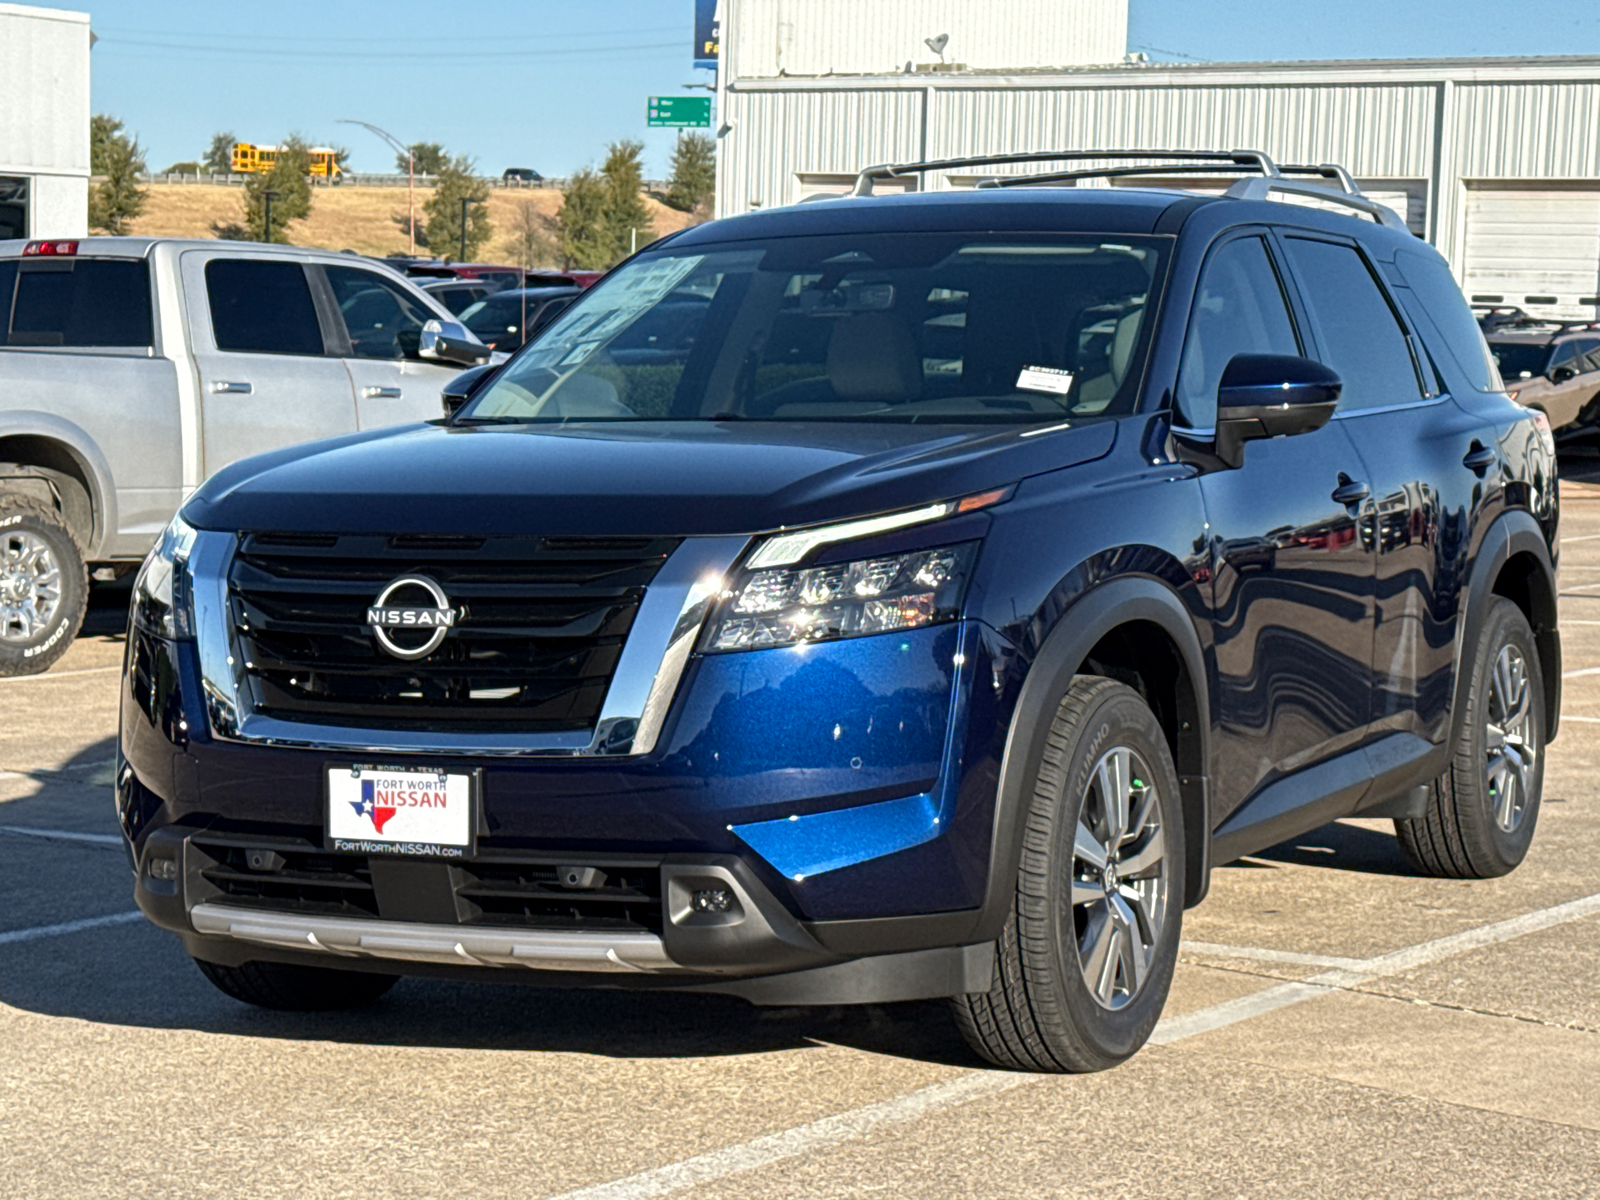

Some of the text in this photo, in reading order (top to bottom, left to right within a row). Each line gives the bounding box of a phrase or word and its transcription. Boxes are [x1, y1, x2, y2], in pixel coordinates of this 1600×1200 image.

[367, 610, 451, 625] NISSAN
[24, 617, 70, 658] COOPER
[1076, 722, 1110, 797] KUMHO
[417, 767, 444, 775] TEXAS
[376, 779, 447, 792] FORT WORTH
[376, 790, 447, 808] NISSAN
